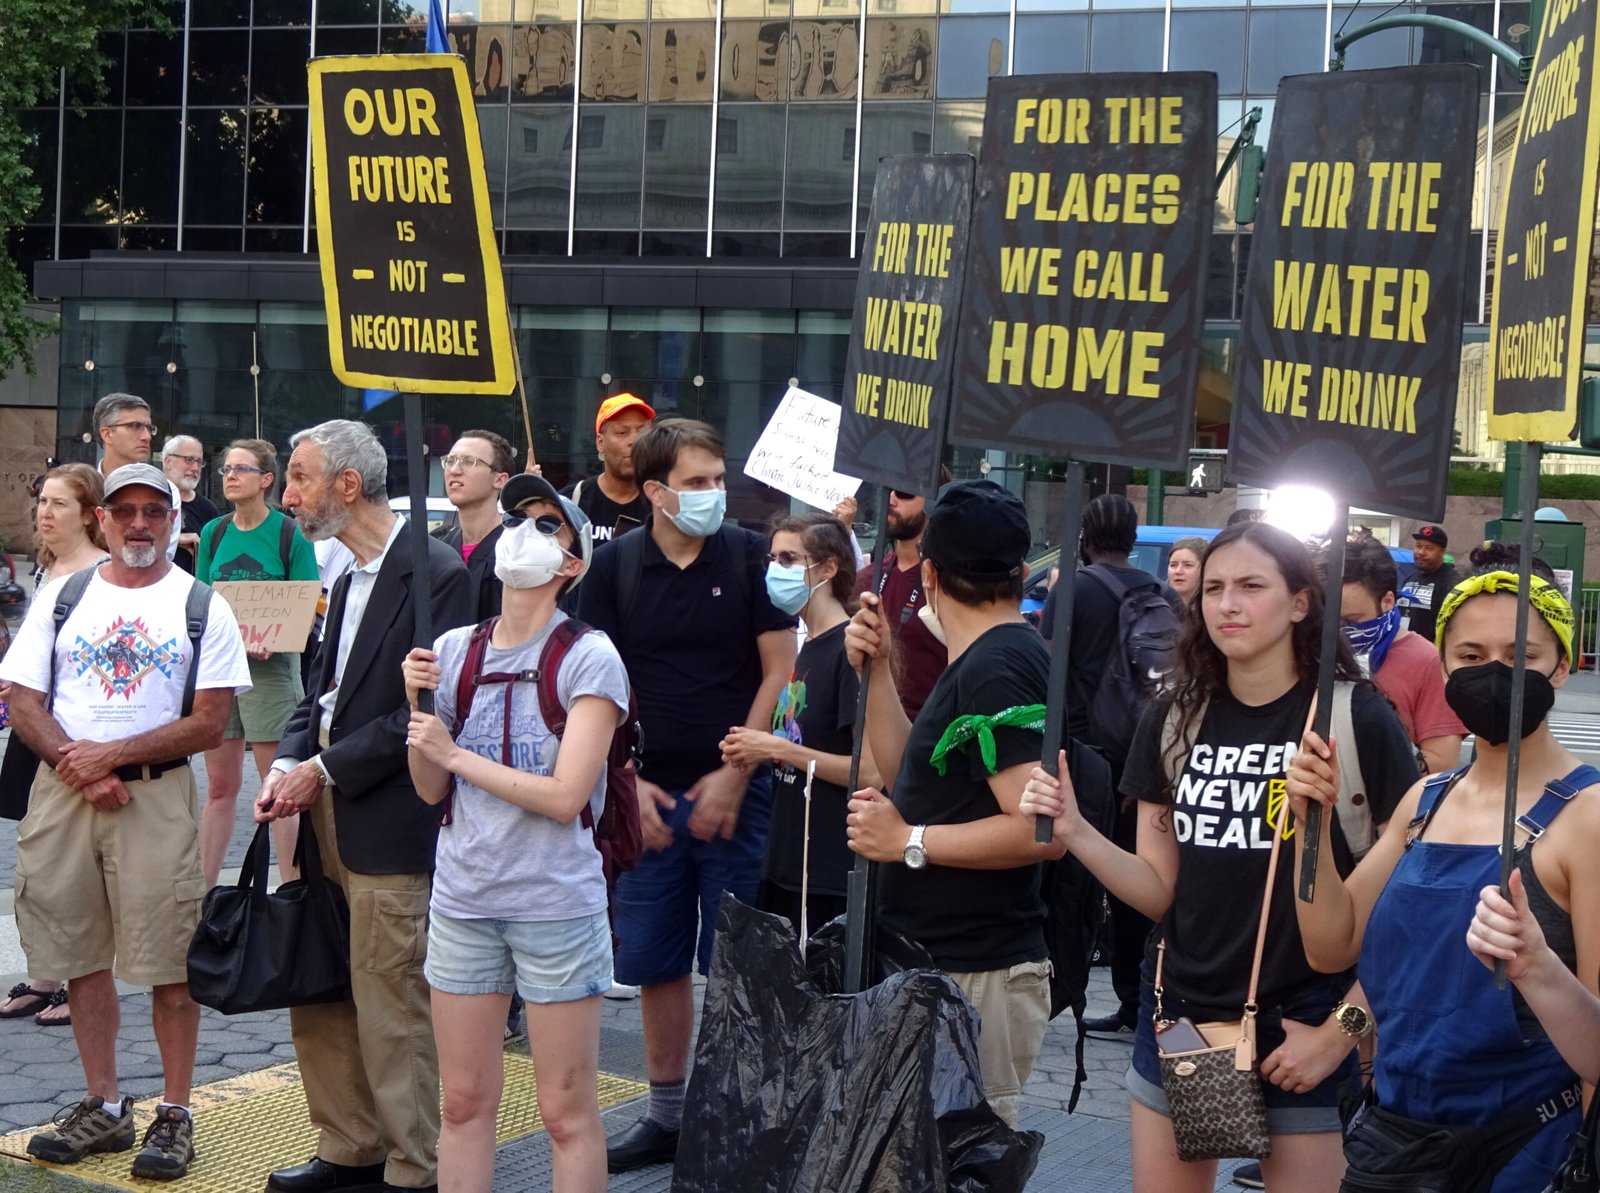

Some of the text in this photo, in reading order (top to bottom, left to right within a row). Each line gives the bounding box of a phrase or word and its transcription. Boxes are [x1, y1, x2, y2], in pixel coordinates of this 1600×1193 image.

[343, 87, 441, 137] OUR
[1524, 35, 1585, 144] FUTURE
[1014, 96, 1183, 144] FOR THE
[348, 155, 452, 204] FUTURE
[1005, 172, 1181, 225] PLACES
[1281, 161, 1442, 233] FOR THE
[1533, 158, 1547, 197] IS
[396, 220, 416, 242] IS
[873, 222, 955, 279] FOR THE
[1524, 221, 1549, 282] NOT
[389, 260, 428, 293] NOT
[1000, 248, 1170, 303] WE CALL
[1273, 260, 1431, 343] WATER
[350, 314, 480, 357] NEGOTIABLE
[864, 296, 943, 361] WATER
[1498, 315, 1567, 382] NEGOTIABLE
[987, 320, 1165, 399] HOME
[785, 393, 832, 430] Future
[856, 373, 933, 430] WE DRINK
[1263, 360, 1422, 434] WE DRINK
[789, 455, 830, 480] fucked
[220, 585, 310, 602] CLIMATE
[233, 607, 292, 621] ACTION
[238, 623, 283, 644] OW!
[464, 741, 545, 769] SORE
[1175, 774, 1268, 812] NEW
[1173, 811, 1273, 849] DEAL
[1560, 1083, 1582, 1109] BA
